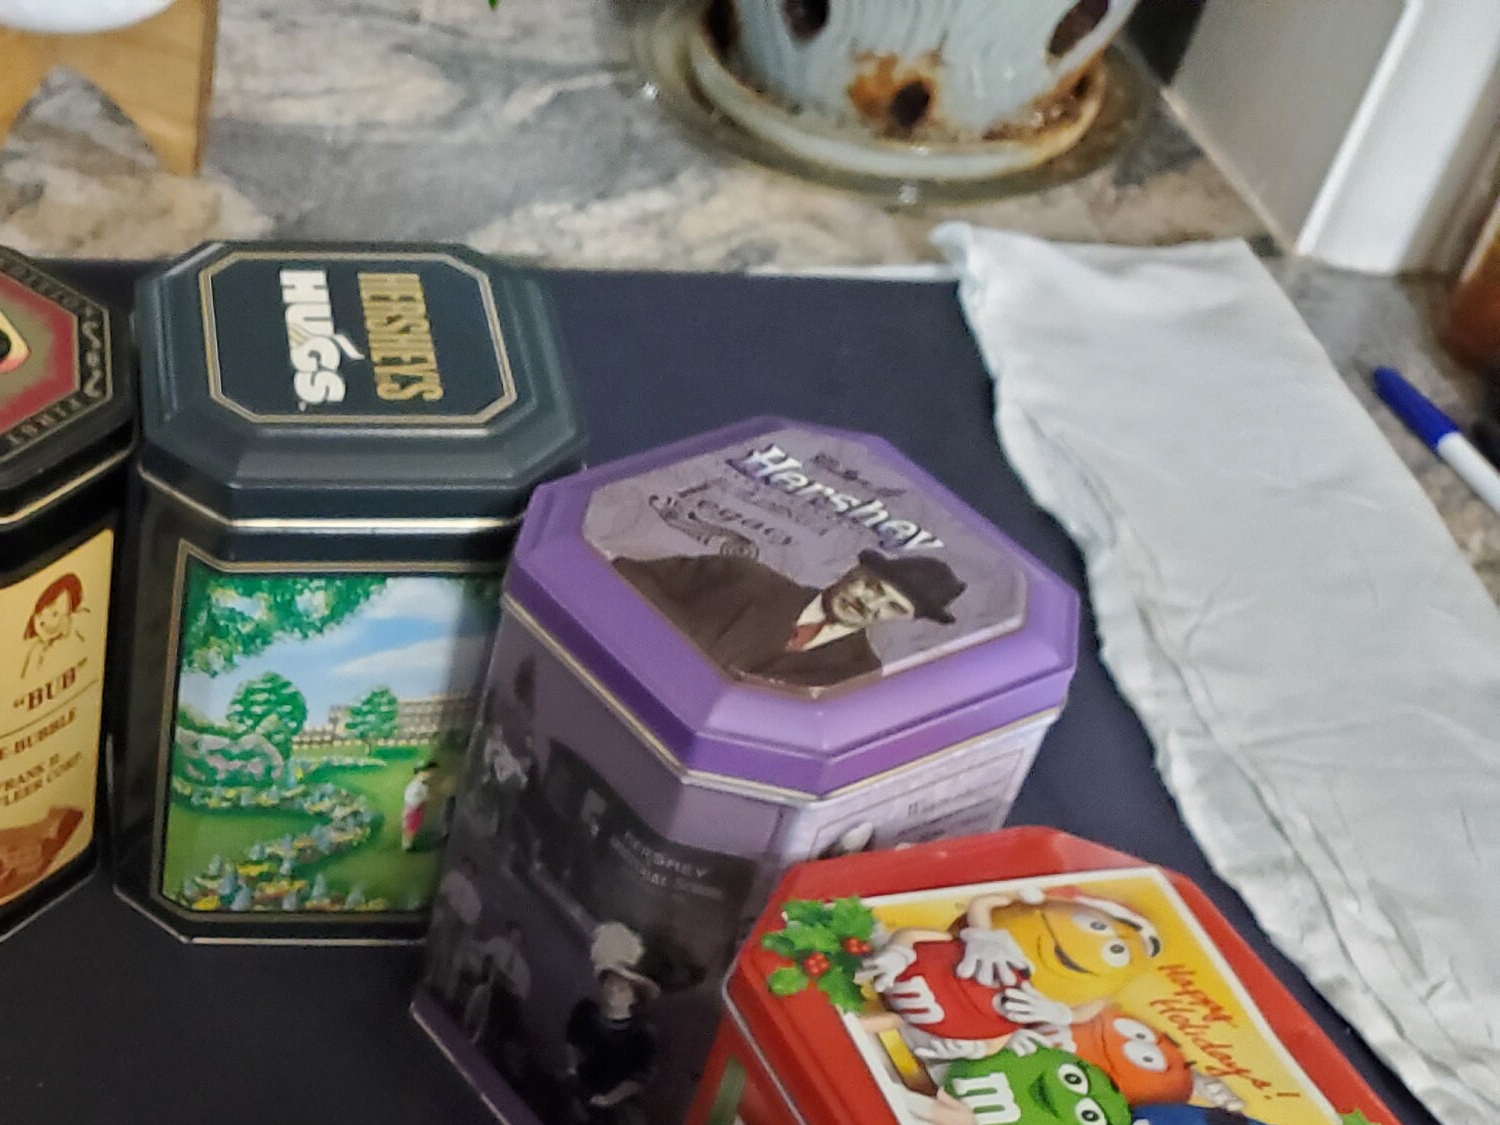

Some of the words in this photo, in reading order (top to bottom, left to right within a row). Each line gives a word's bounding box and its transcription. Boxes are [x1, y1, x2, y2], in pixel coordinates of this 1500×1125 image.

[736, 441, 945, 550] Hershey
[13, 706, 77, 756] BUBBLE
[1156, 963, 1240, 1029] Happy
[1148, 998, 1301, 1100] Holidays!
